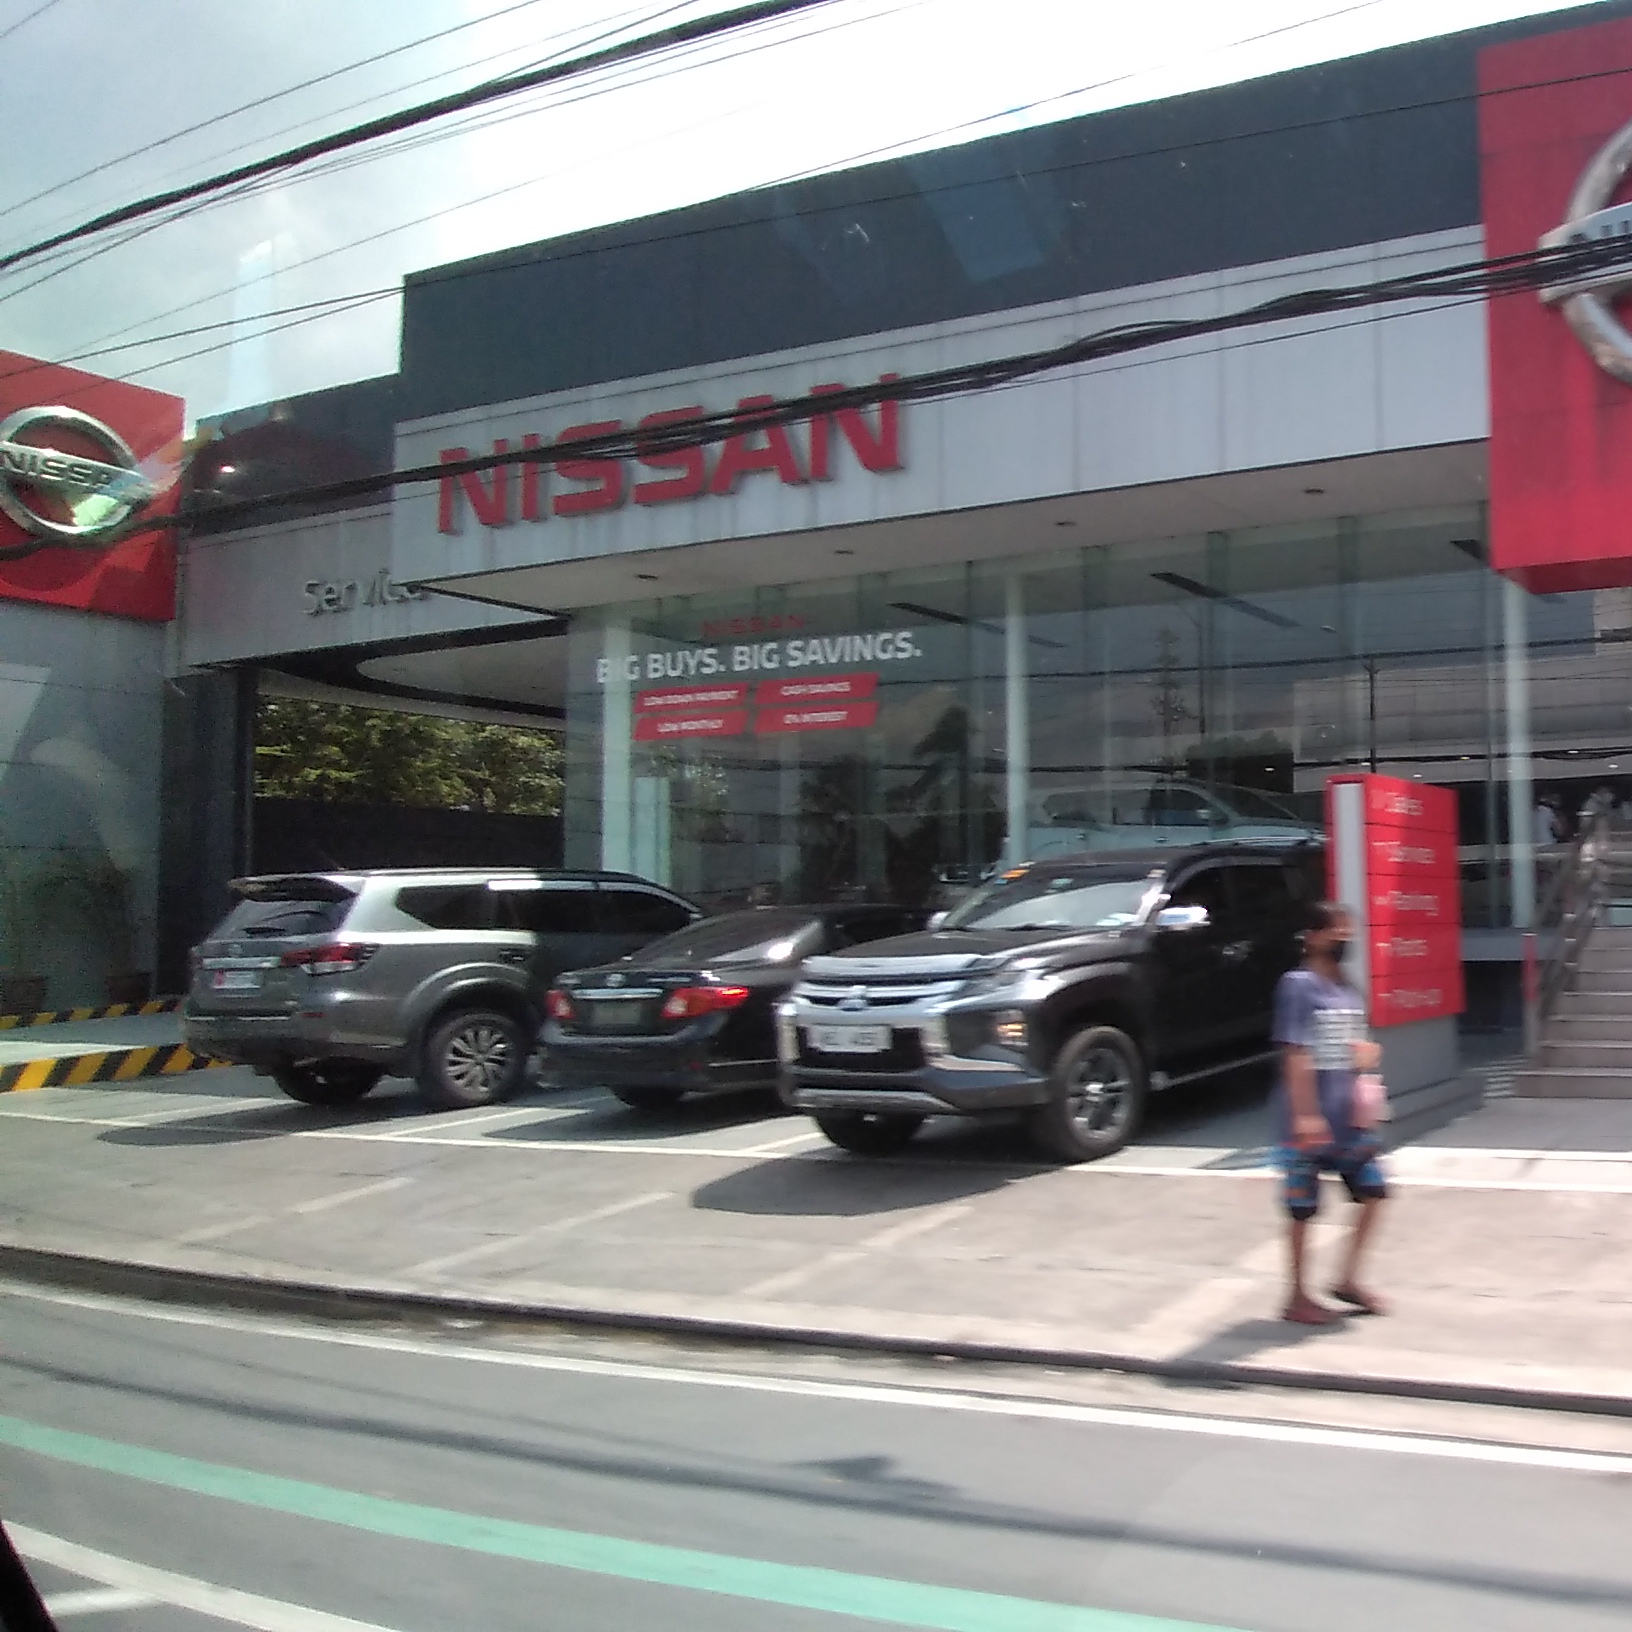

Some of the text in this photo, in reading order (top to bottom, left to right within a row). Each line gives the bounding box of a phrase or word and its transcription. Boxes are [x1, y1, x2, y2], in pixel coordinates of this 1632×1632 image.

[0, 449, 126, 490] NISS
[438, 373, 902, 534] NISSAN
[596, 631, 923, 683] BG BUYS. BIG SAVINGS.
